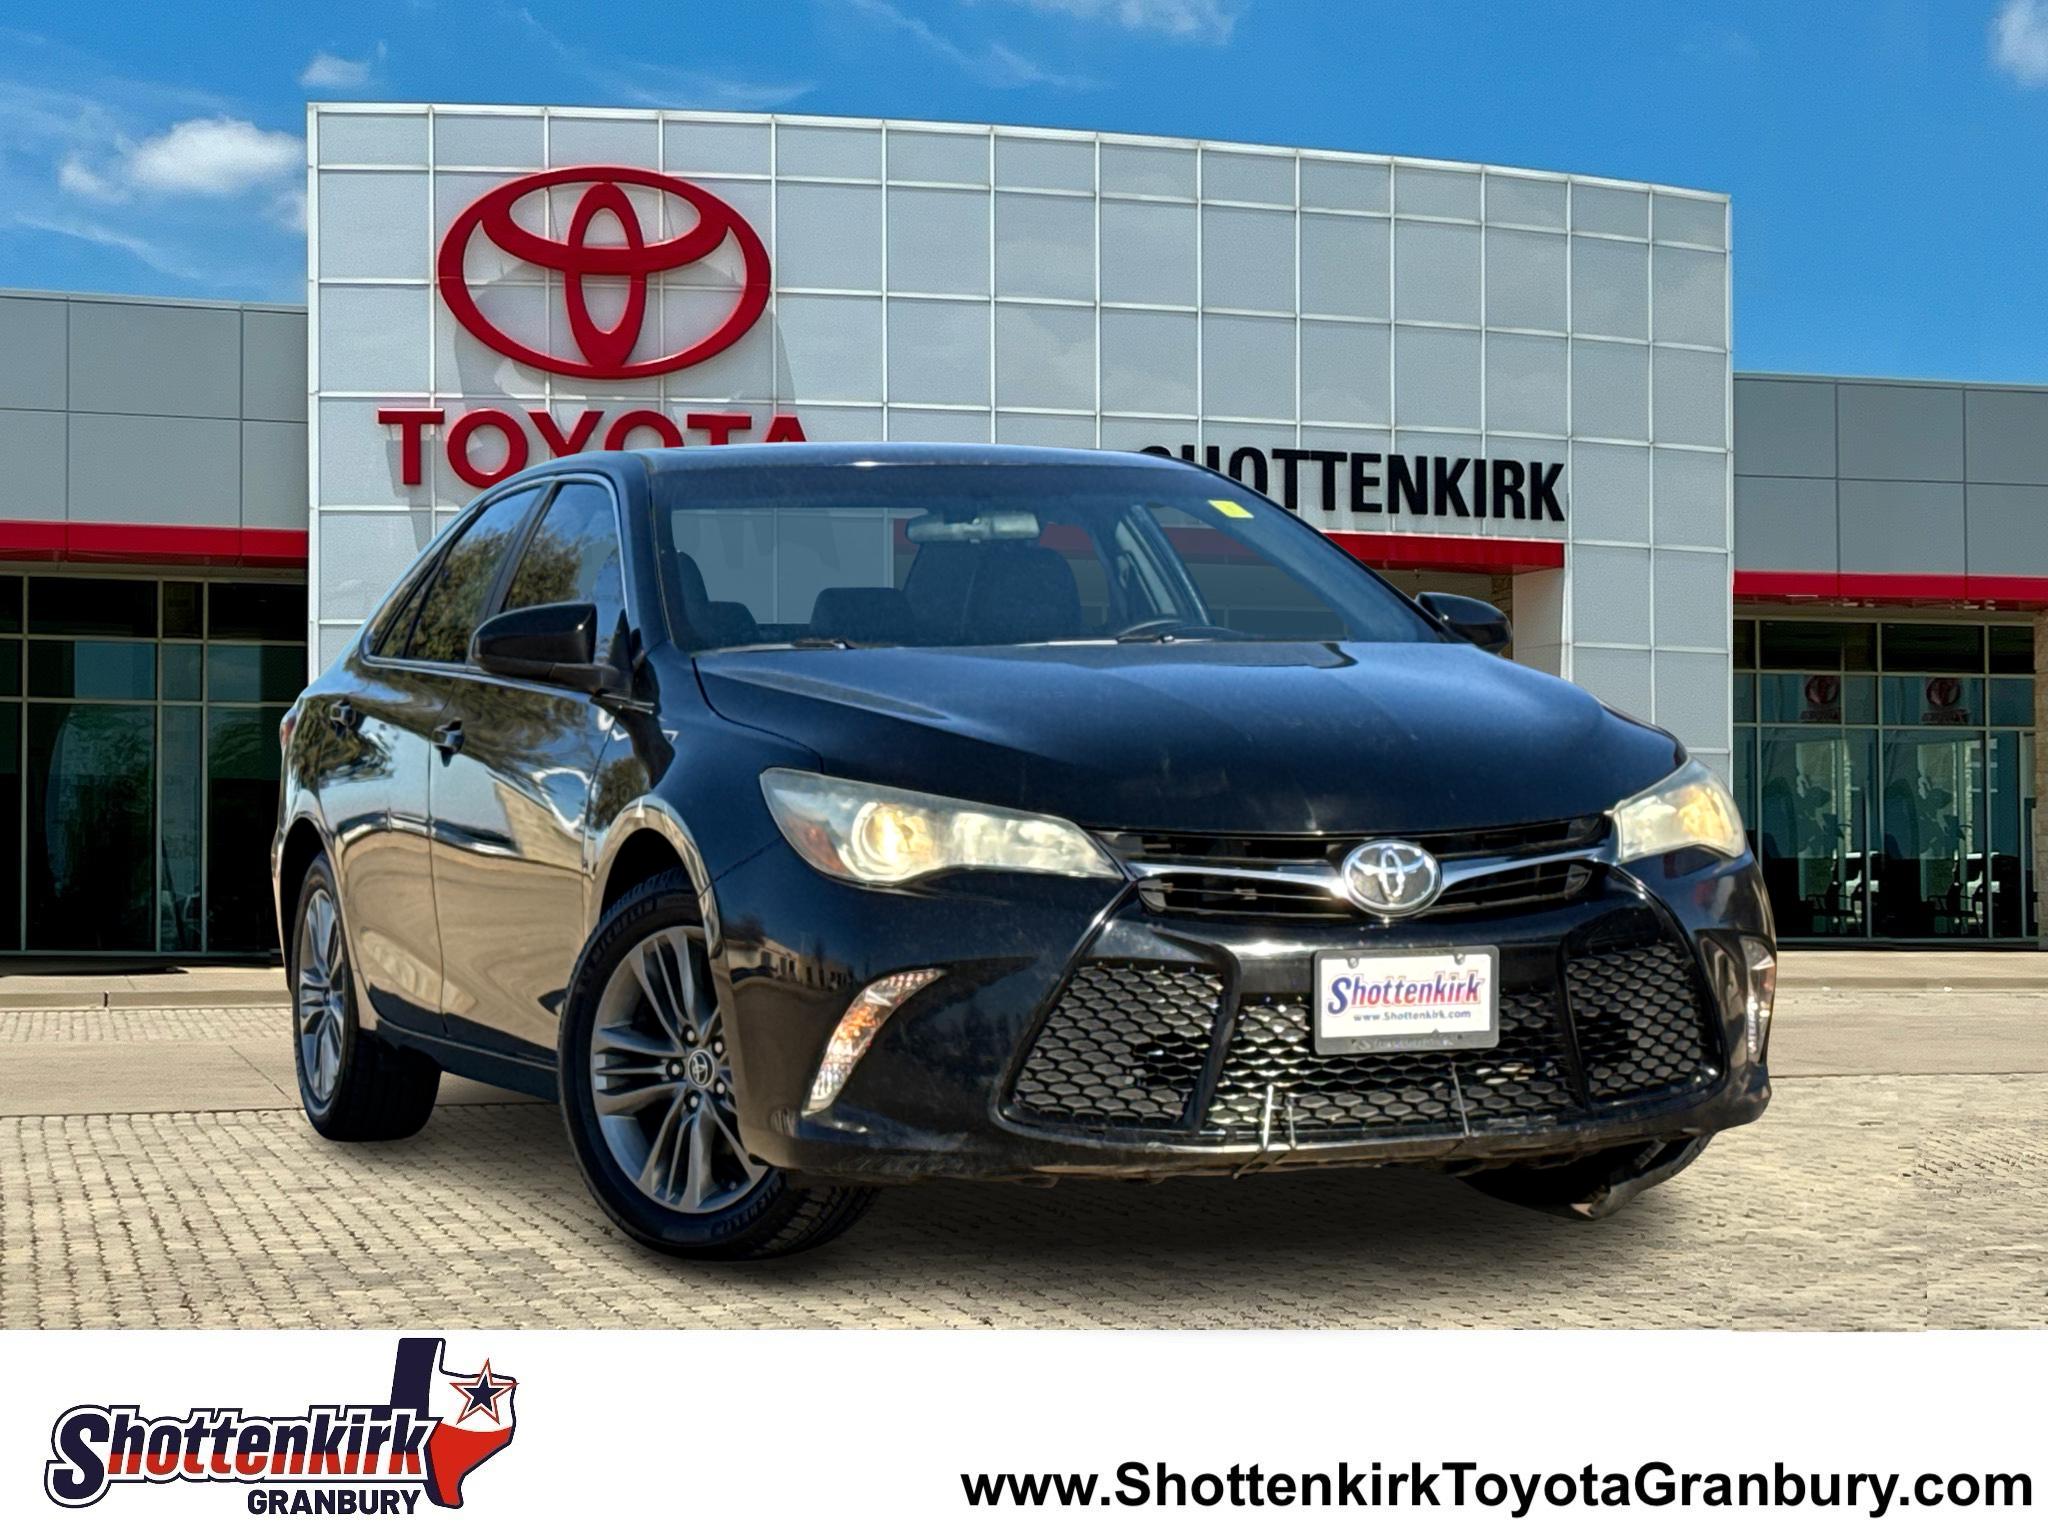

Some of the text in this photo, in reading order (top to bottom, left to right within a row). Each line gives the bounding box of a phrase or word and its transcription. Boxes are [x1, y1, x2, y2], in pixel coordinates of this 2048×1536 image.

[1139, 444, 1566, 521] OTTENKIRK
[1327, 971, 1483, 1015] Shottenkirk
[1353, 1009, 1472, 1022] www.Shottenkirk.com
